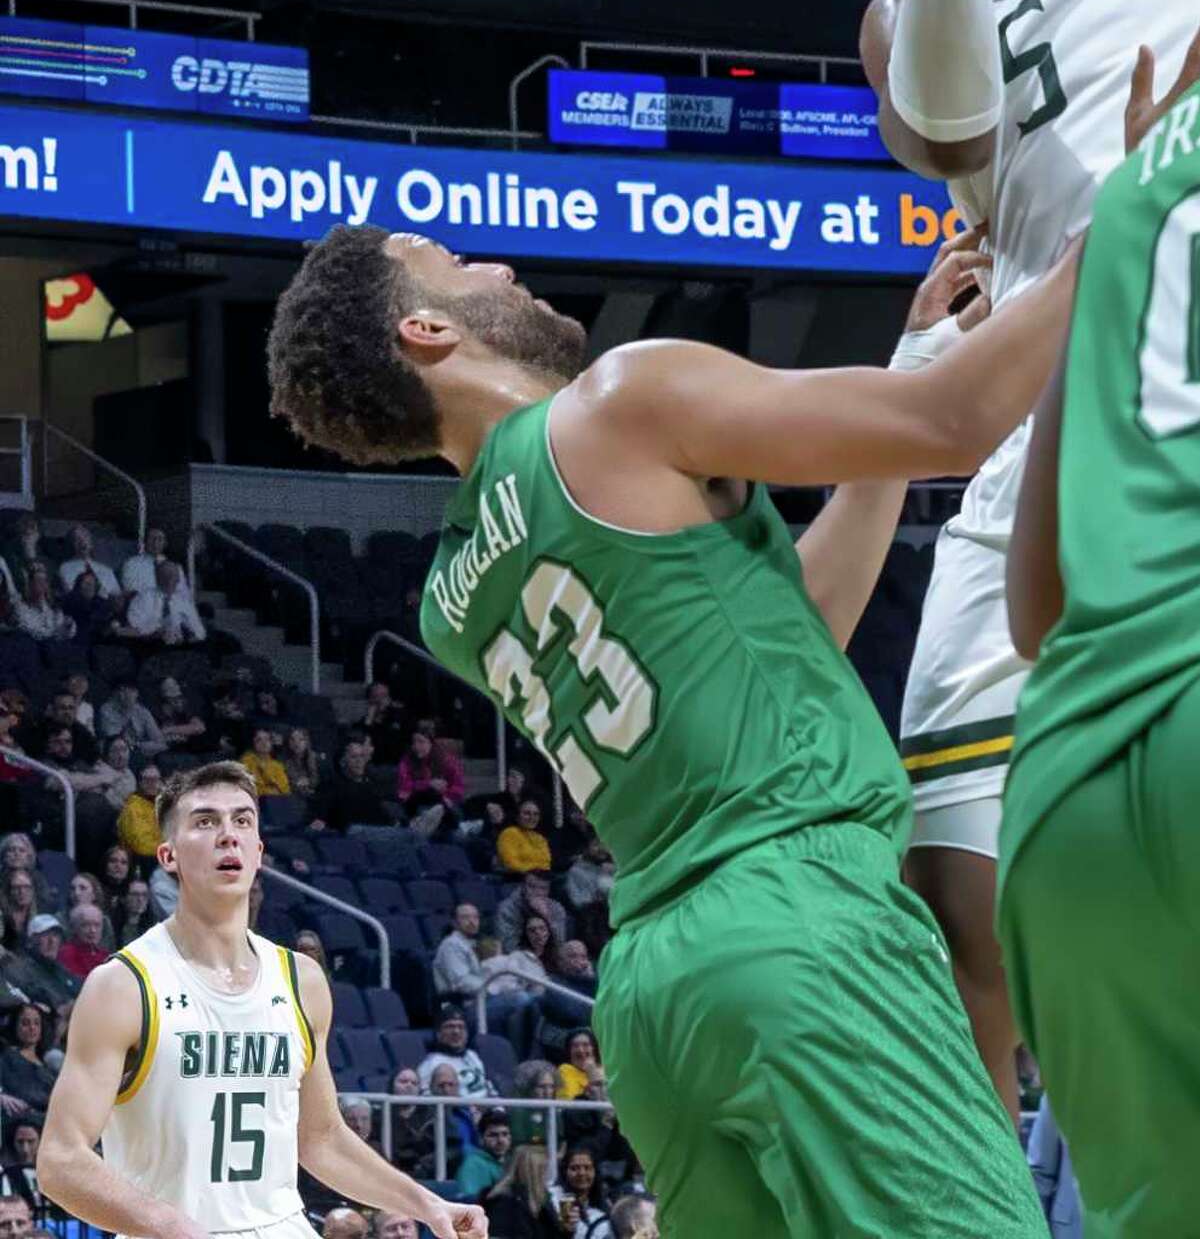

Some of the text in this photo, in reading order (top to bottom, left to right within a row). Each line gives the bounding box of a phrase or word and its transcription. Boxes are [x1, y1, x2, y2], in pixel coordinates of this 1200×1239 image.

[171, 55, 290, 100] CDTA
[561, 110, 630, 128] MEMBERS
[635, 112, 725, 130] ESSENTIAL
[647, 95, 715, 113] ALWAYS
[0, 137, 58, 192] m!
[203, 149, 379, 226] Apply
[396, 167, 598, 231] Online
[616, 180, 802, 251] Today
[820, 194, 879, 244] at
[480, 554, 661, 813] 23
[174, 1030, 292, 1079] SIENA
[210, 1091, 267, 1184] 15
